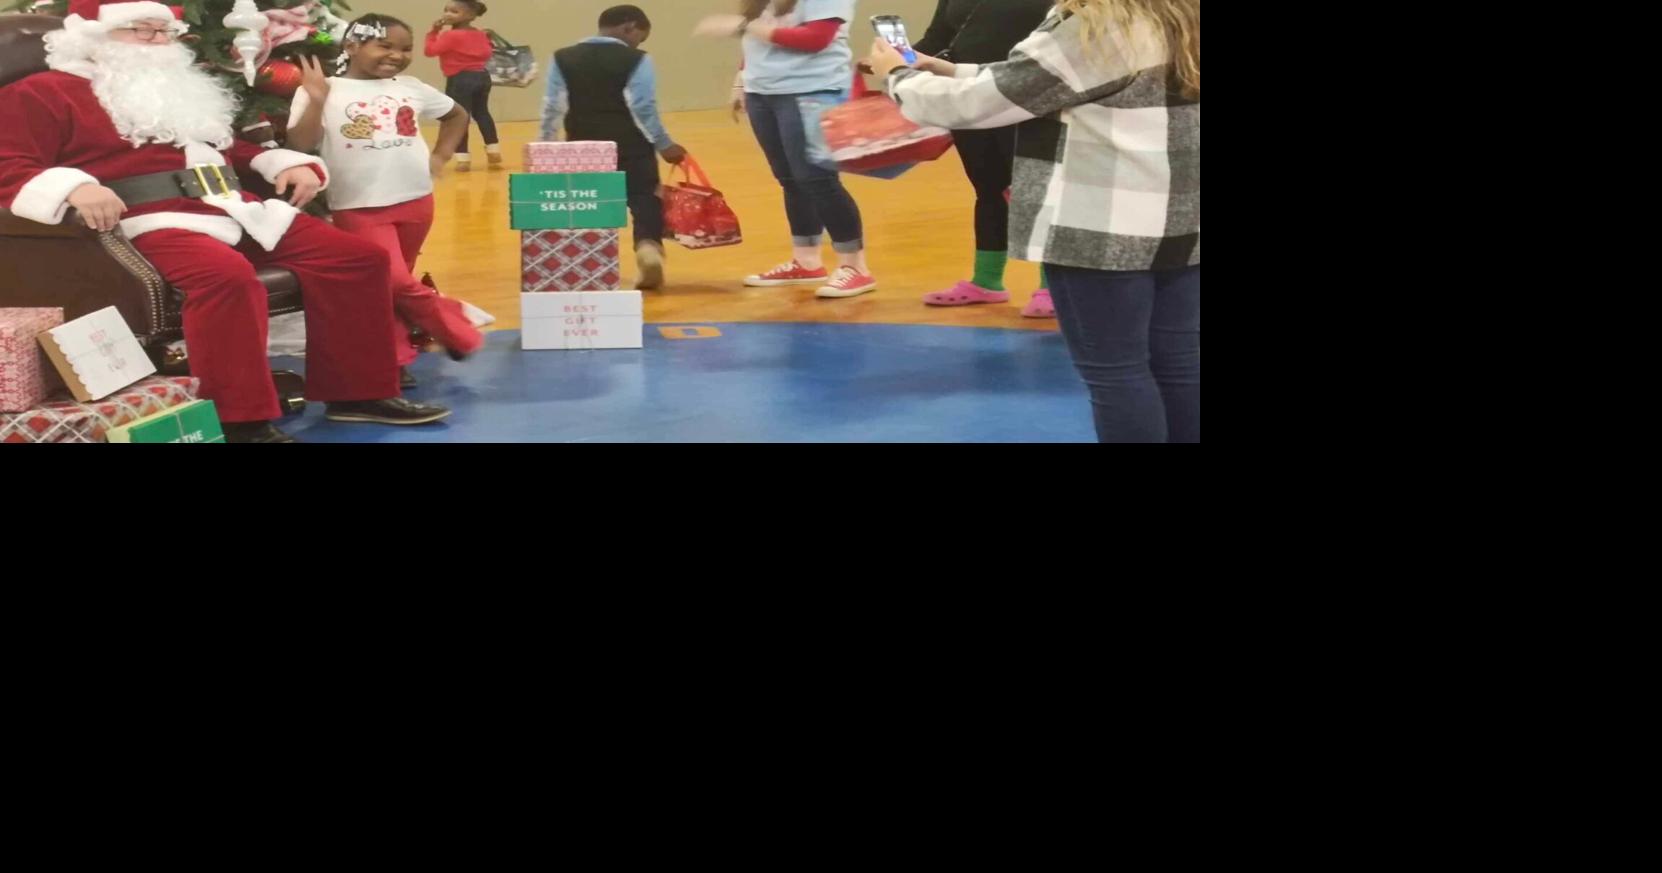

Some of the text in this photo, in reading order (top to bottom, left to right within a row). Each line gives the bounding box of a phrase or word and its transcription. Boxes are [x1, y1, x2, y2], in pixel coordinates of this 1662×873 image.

[570, 189, 598, 198] THE
[540, 202, 598, 211] SEASON
[563, 304, 597, 313] BEST
[563, 329, 599, 338] EVER
